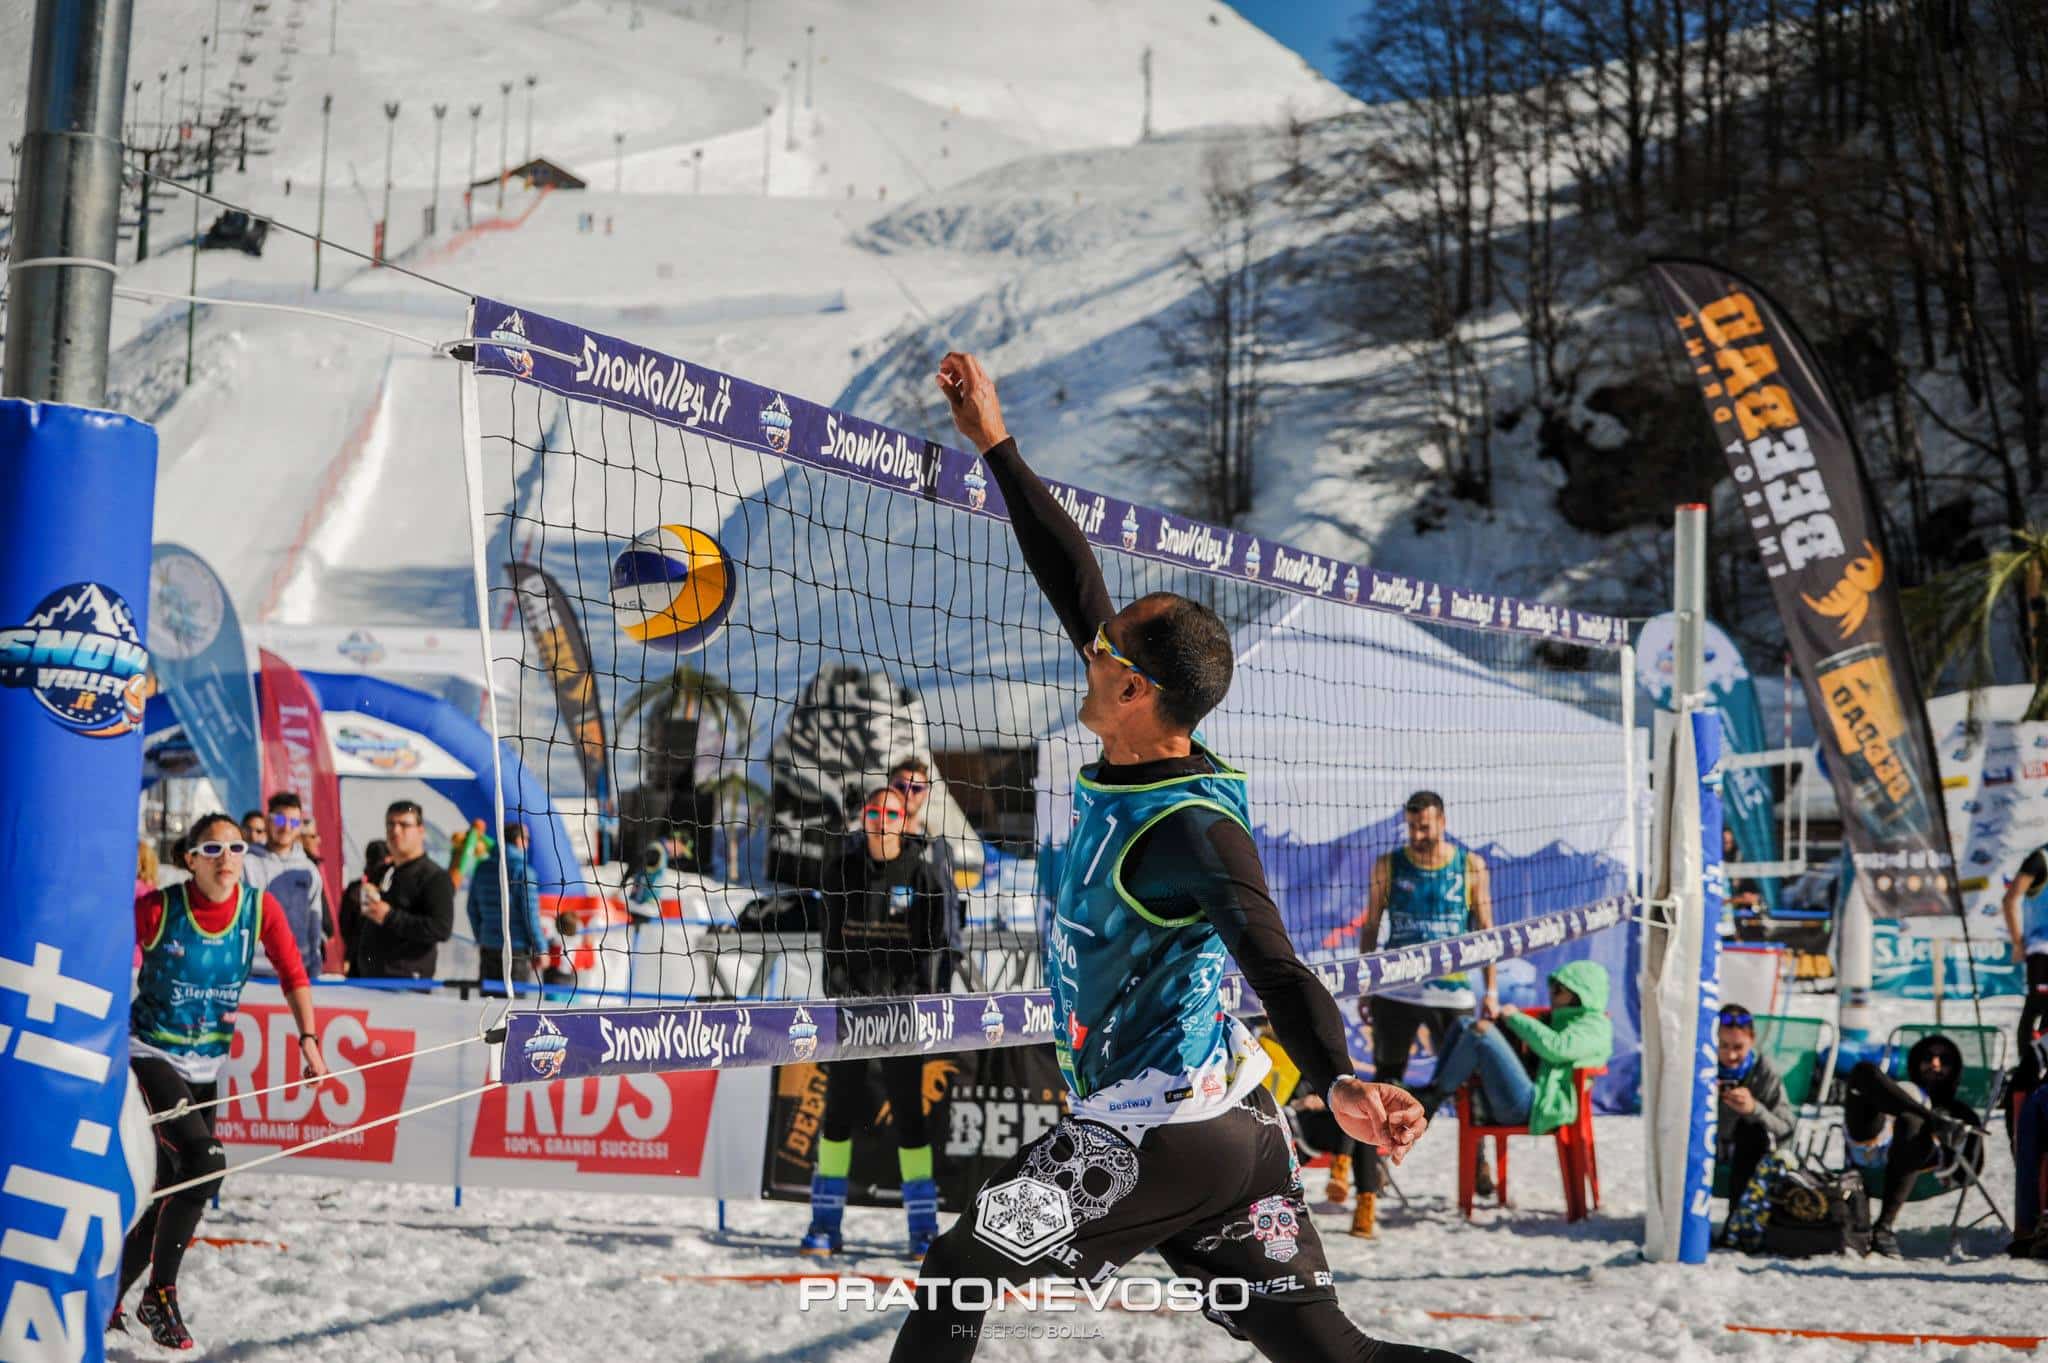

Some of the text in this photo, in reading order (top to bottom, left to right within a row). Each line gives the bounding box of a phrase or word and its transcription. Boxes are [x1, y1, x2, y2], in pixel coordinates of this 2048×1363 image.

[576, 335, 731, 426] SnowVolley.it
[821, 413, 942, 491] SnowVolley.it
[0, 628, 149, 675] SNOW
[37, 667, 130, 699] VOLLEY
[1083, 813, 1118, 886] 1
[1444, 871, 1464, 903] 2
[240, 928, 250, 965] 1
[600, 1009, 752, 1067] SnowVolley.it
[842, 1000, 955, 1050] SnowVolley.it
[217, 1011, 368, 1126] RDS
[1108, 1095, 1153, 1111] Bestway
[214, 1121, 246, 1138] 00%
